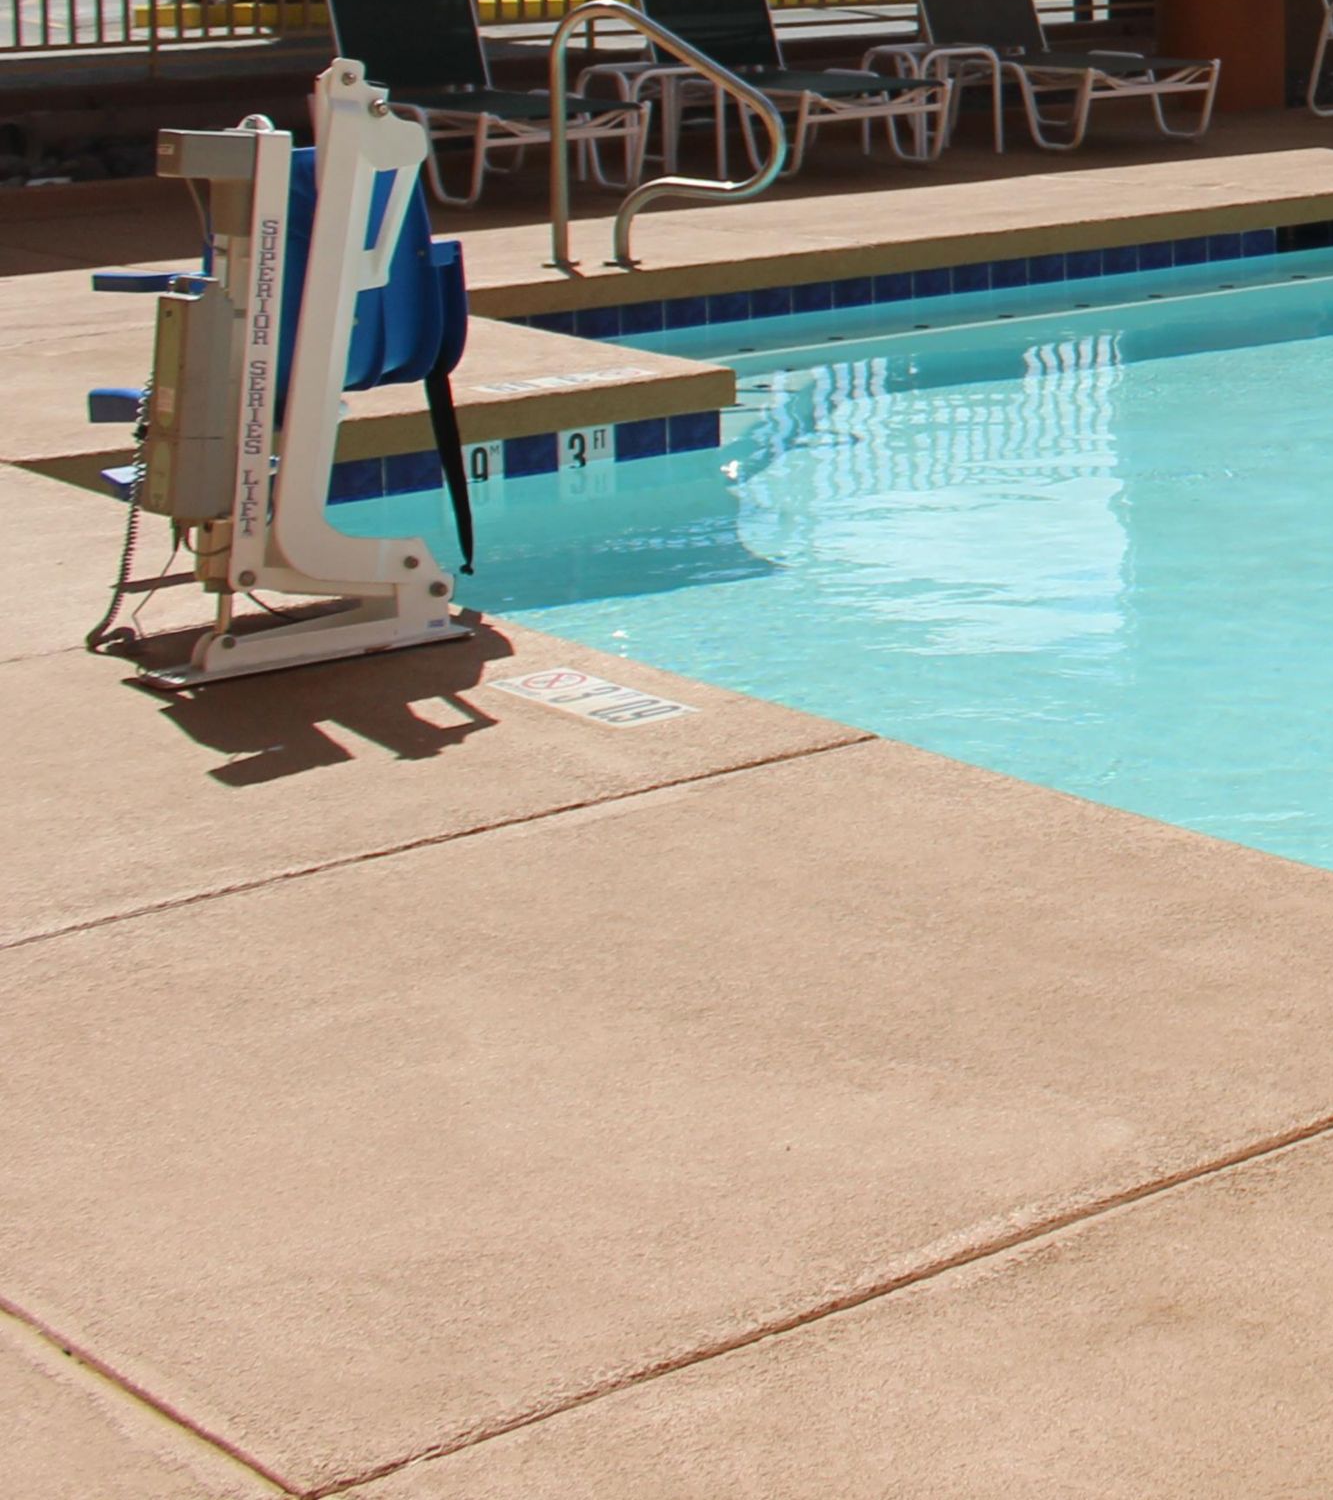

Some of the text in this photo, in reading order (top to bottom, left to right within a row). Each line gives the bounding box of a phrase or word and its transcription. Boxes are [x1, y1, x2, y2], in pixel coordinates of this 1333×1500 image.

[239, 219, 279, 536] SUPERIOR SERIES LIFT
[568, 428, 607, 470] 3 FT
